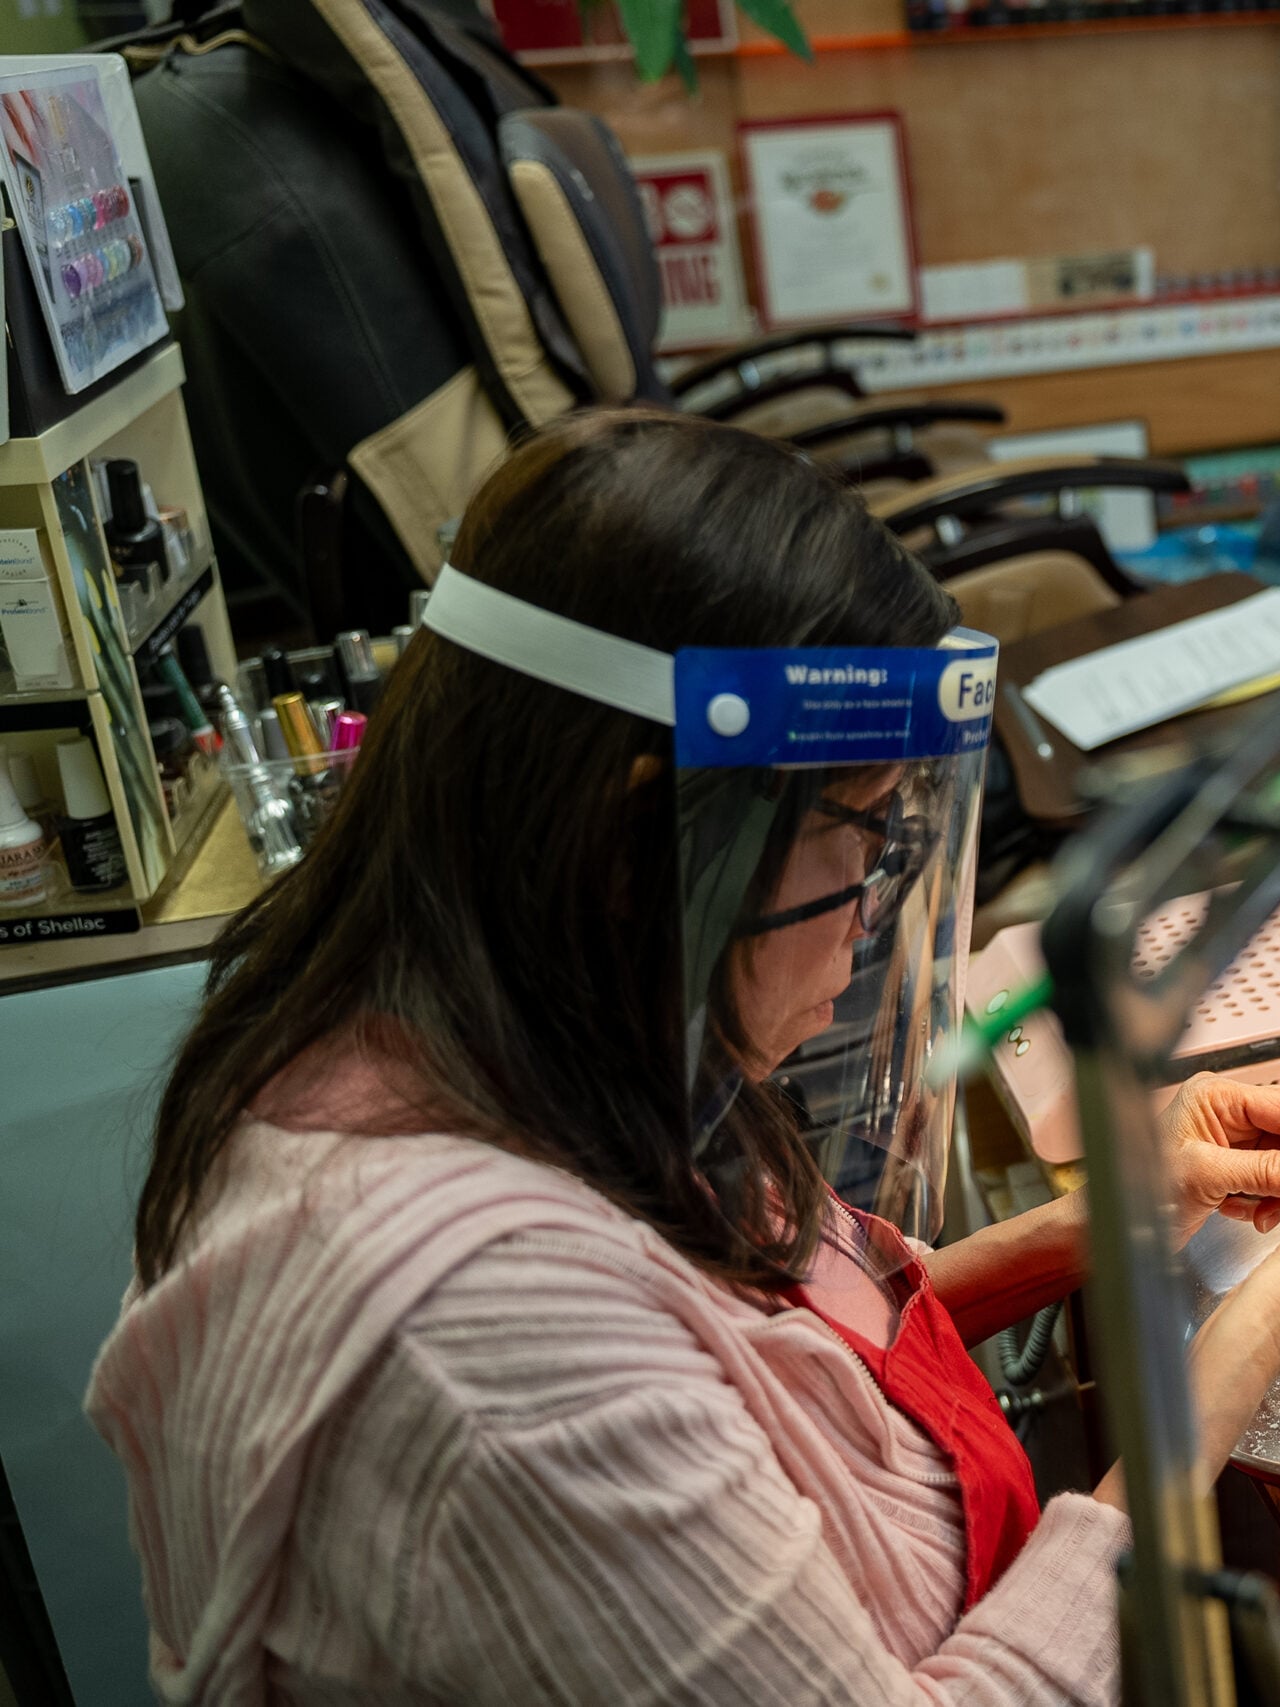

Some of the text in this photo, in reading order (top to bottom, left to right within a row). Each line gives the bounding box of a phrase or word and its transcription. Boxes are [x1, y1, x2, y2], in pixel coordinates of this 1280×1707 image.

[784, 664, 888, 687] Warning:
[13, 921, 32, 937] of
[38, 917, 106, 935] Shellac
